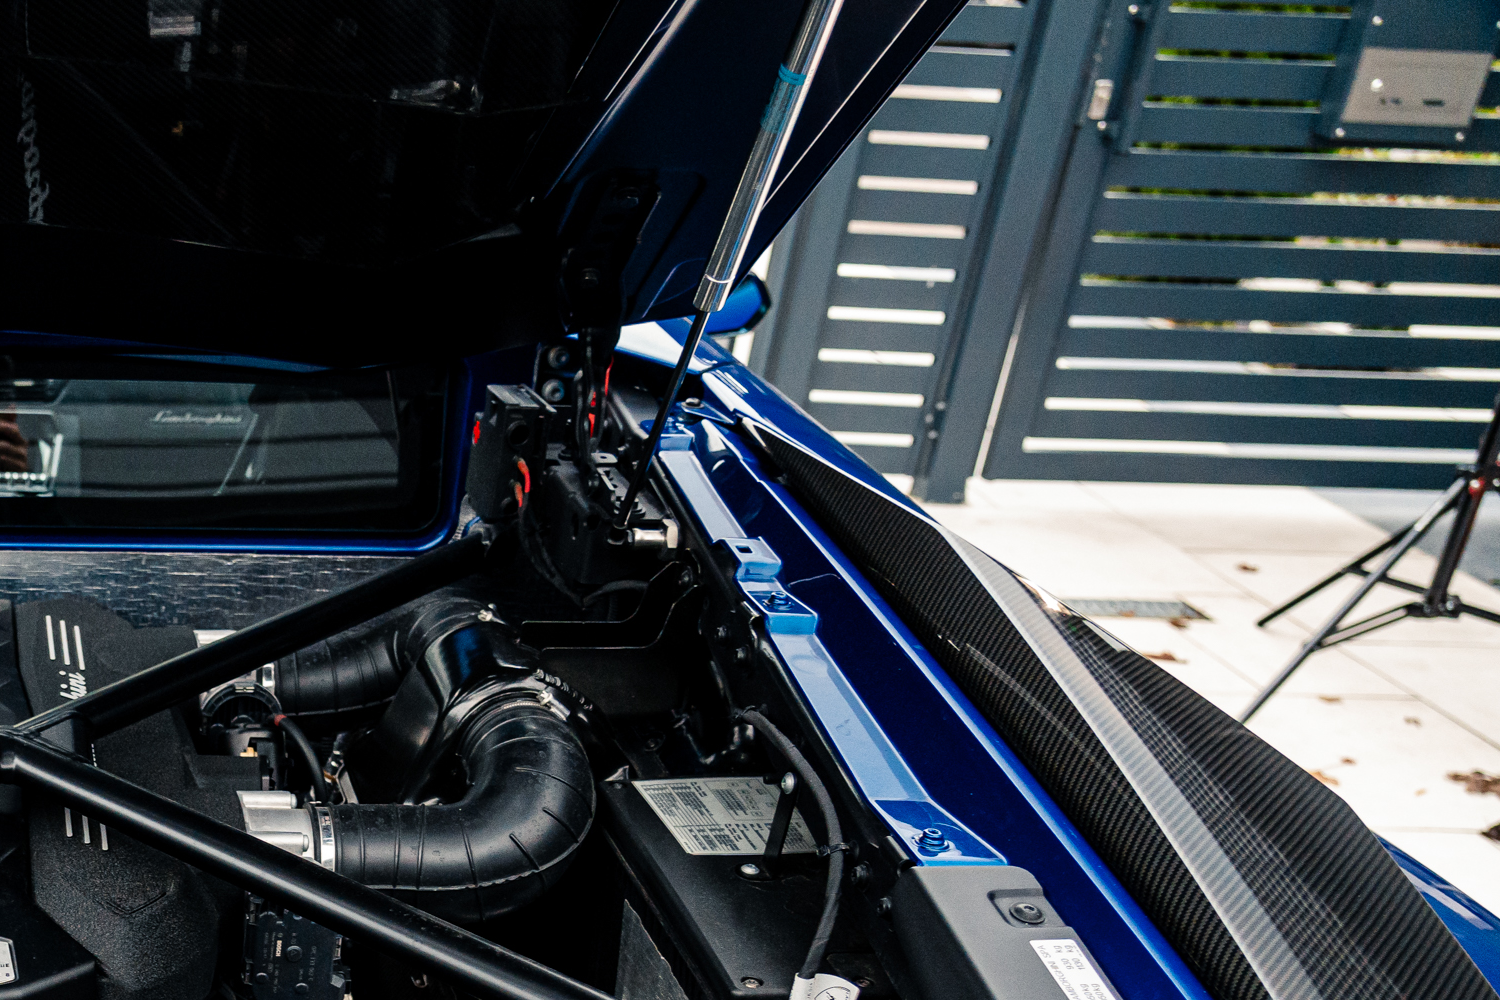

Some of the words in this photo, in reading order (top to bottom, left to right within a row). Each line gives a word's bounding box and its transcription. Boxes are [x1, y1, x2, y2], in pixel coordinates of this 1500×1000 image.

[1037, 945, 1052, 959] SPA
[1053, 945, 1063, 953] kg
[1064, 945, 1075, 953] kg
